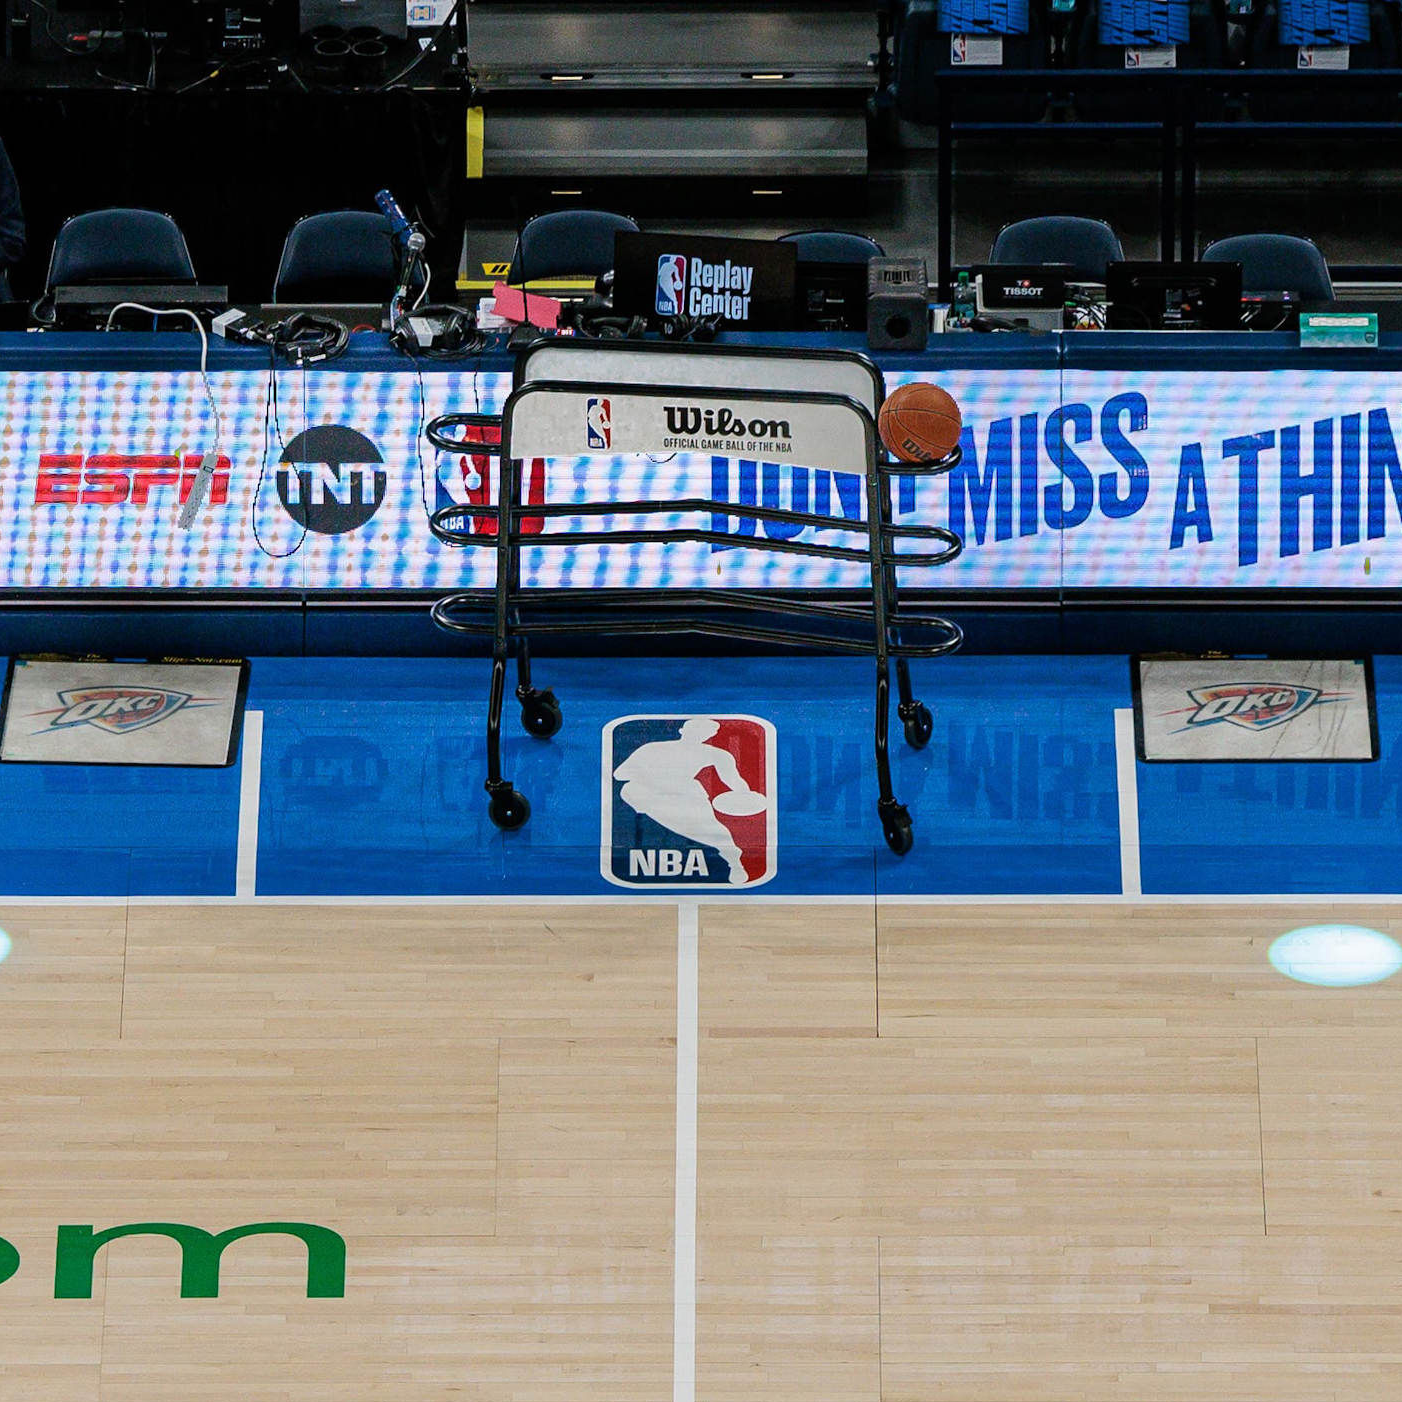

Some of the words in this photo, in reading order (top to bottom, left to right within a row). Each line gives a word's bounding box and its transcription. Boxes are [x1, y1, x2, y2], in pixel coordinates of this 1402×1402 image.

[690, 258, 753, 295] Replay
[1003, 287, 1043, 296] TISSOT
[689, 287, 751, 320] Center
[663, 406, 792, 438] Wilson
[663, 438, 699, 449] OFFICIAL
[701, 439, 724, 450] GAME
[726, 440, 746, 451] BALL
[747, 441, 756, 452] OF
[759, 441, 773, 452] THE
[776, 442, 792, 453] NBA
[277, 462, 386, 505] TNT
[947, 391, 1148, 549] MISS
[1169, 442, 1213, 551] A
[53, 692, 162, 726] OKC
[1188, 690, 1290, 724] OKC
[629, 849, 710, 877] NBA
